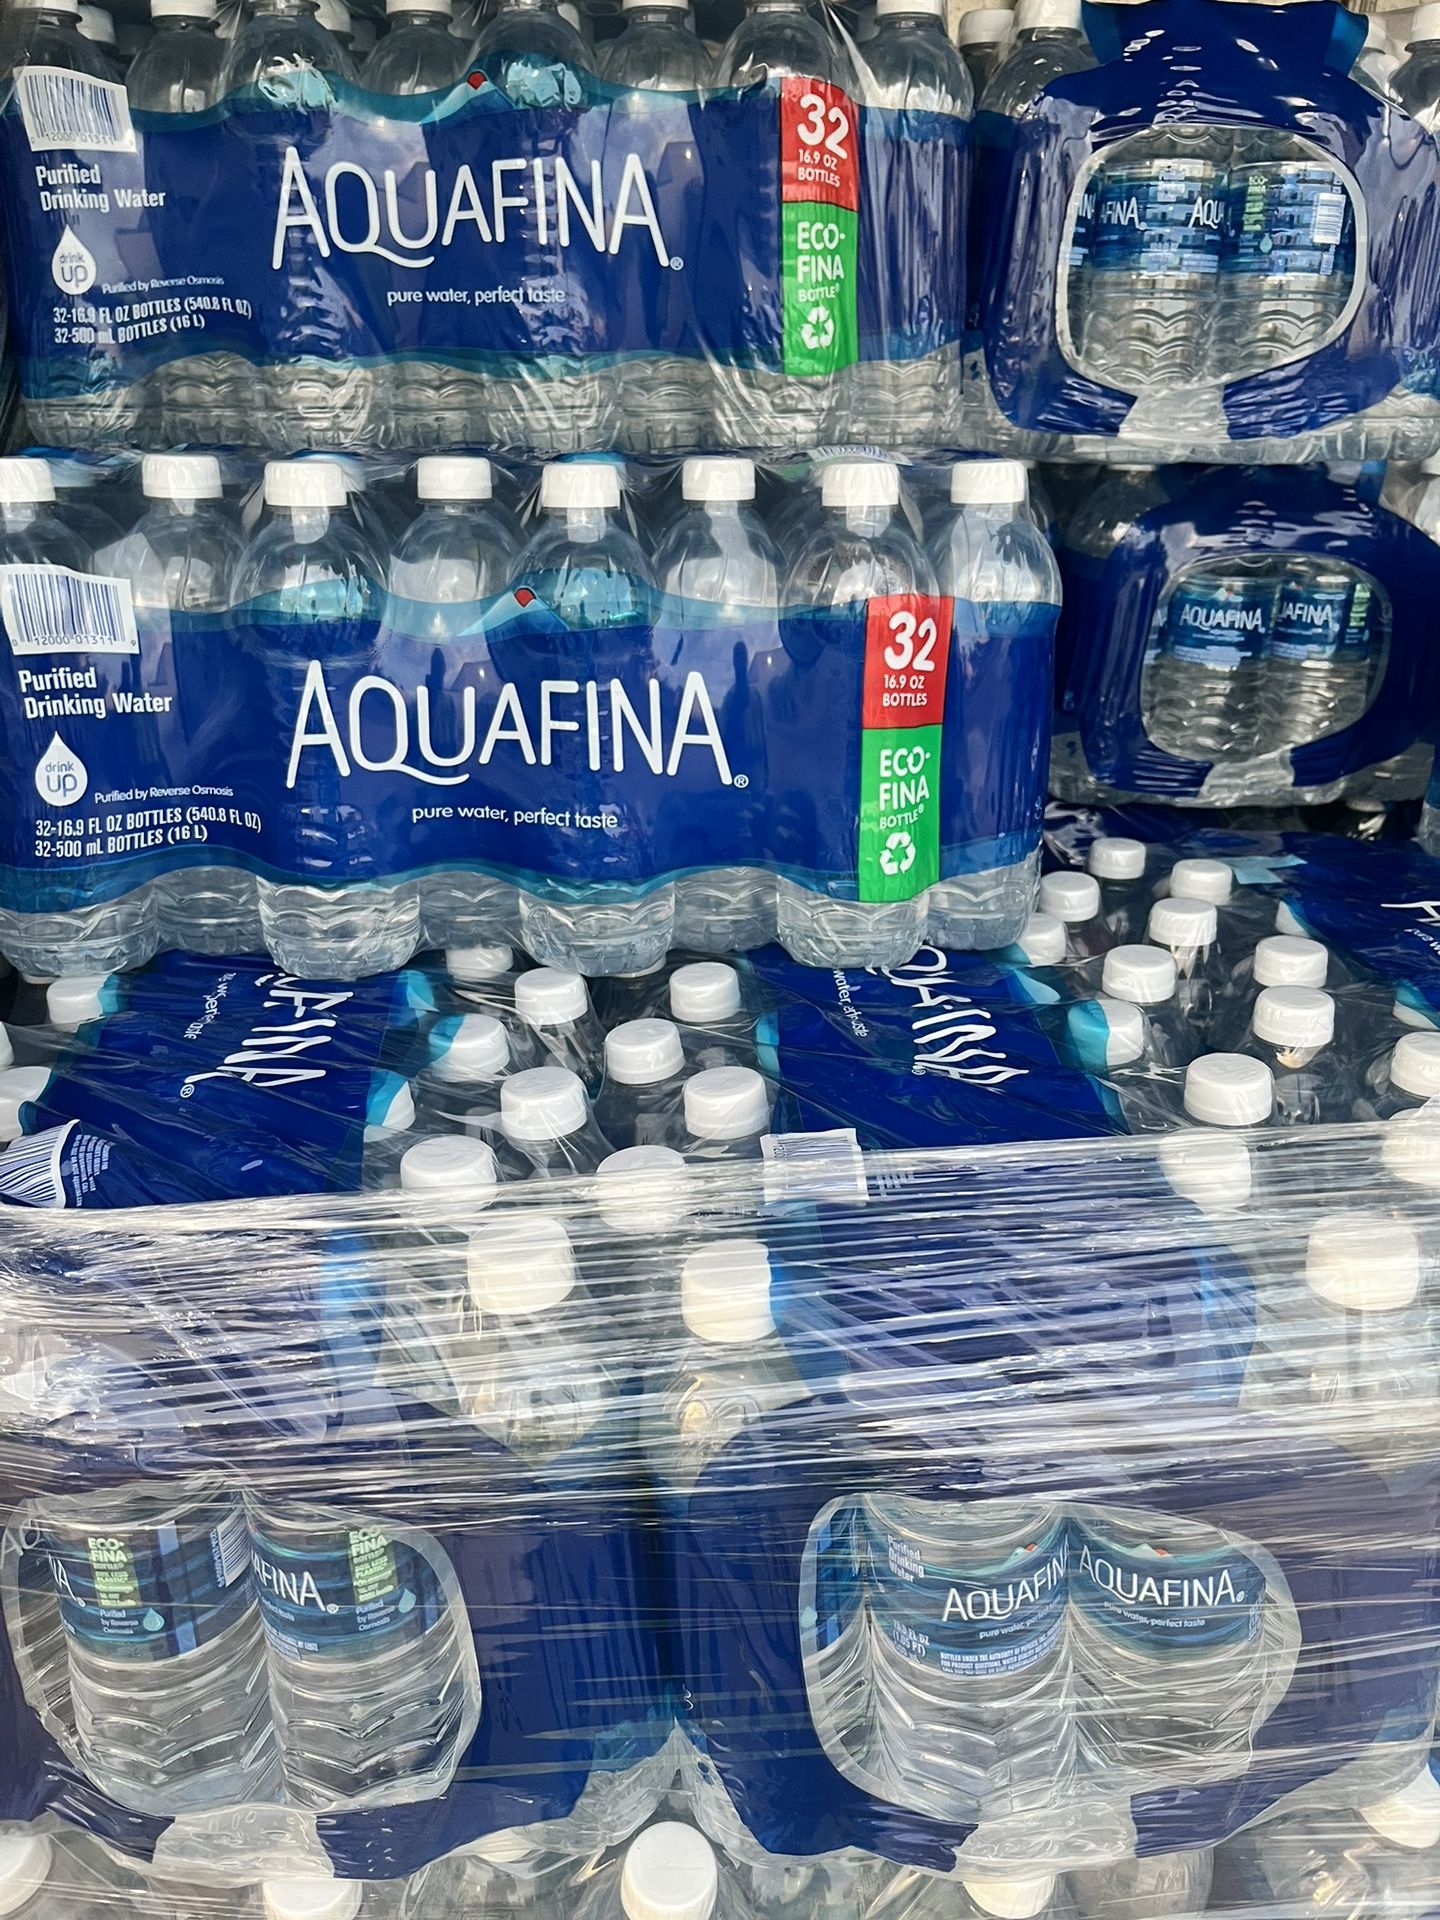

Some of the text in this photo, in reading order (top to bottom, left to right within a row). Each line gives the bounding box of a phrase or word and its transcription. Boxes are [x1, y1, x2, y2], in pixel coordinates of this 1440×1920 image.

[797, 93, 849, 160] 32
[798, 149, 837, 171] 16.9 OZ
[35, 163, 101, 187] Purified
[798, 167, 840, 188] BOTTLES
[40, 188, 165, 213] Drinking Water
[59, 253, 84, 264] drink
[797, 254, 845, 284] FINA
[102, 276, 224, 294] Purified by Reverse Osmosis
[387, 286, 565, 307] pure water, perfect taste
[53, 296, 252, 323] 32-16.9 FL OZ BOTTLES (540.8 FL OZ)
[54, 314, 205, 344] 32-500 mL BOTTLES (16 L)
[34, 634, 70, 646] 12000
[75, 634, 113, 646] 01311
[883, 610, 938, 671] 32
[18, 667, 97, 693] Purified
[883, 674, 925, 690] 16.9 OZ
[24, 692, 172, 720] Drinking Water
[882, 691, 928, 707] BOTTLES
[45, 761, 74, 772] drink
[94, 785, 234, 803] Purified by Reverse Osmosis
[879, 775, 930, 811] FINA
[35, 806, 262, 837] 32-16.9 FL OZ BOTTLES (540.8 FL OZ)
[411, 804, 618, 829] pure water, perfect taste
[35, 824, 208, 857] 32-500 mL BOTTLES (16 L)
[349, 1526, 386, 1544] ECO
[351, 1535, 388, 1557] FINA
[888, 1534, 921, 1560] Purified
[91, 1550, 128, 1562] FINA
[889, 1547, 925, 1578] Drinking
[942, 1533, 1069, 1621] AQUAFIN
[1079, 1544, 1236, 1607] AQUAFINA
[980, 1629, 1000, 1639] pure
[1184, 1619, 1205, 1627] taste
